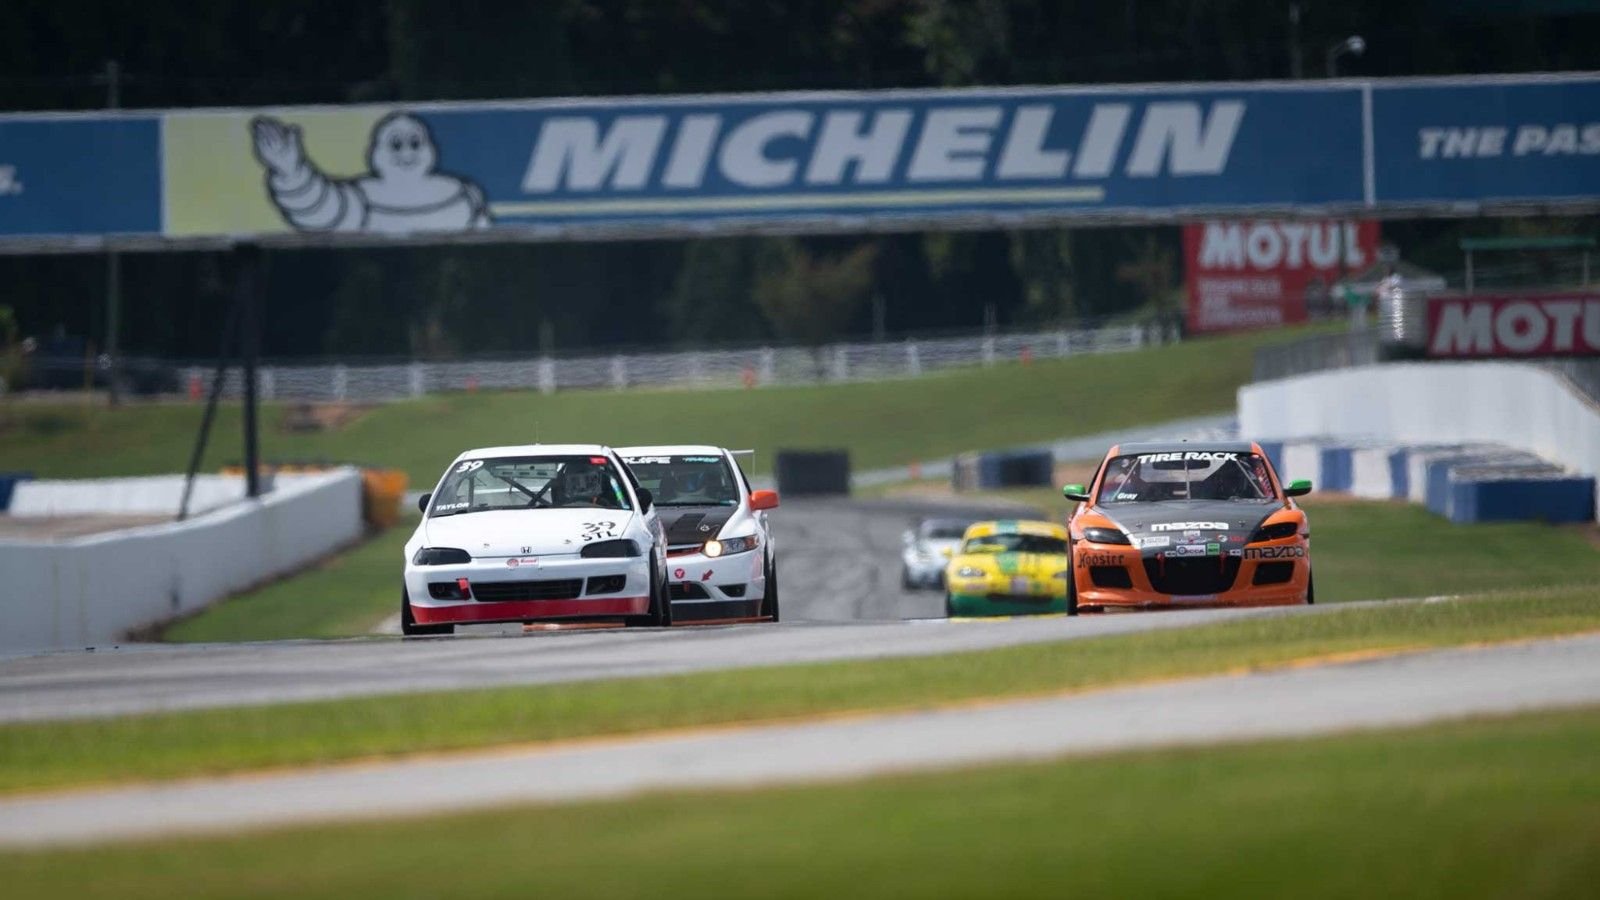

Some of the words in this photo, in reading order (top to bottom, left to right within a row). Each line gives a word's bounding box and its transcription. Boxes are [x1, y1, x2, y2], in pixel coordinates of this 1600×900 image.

[522, 100, 1246, 193] MICHELIN
[1419, 127, 1507, 159] THE
[1514, 123, 1600, 156] PAS
[1201, 222, 1365, 269] MOTUL
[1138, 452, 1183, 464] TIRE
[1184, 452, 1238, 461] RACK
[456, 460, 484, 473] 39
[1117, 492, 1138, 500] Gray
[436, 502, 470, 511] TAYLOR
[582, 521, 616, 533] 39
[1151, 521, 1229, 532] mazda
[581, 531, 618, 541] STL
[1244, 546, 1305, 560] mazda
[1077, 551, 1125, 568] Hoosier
